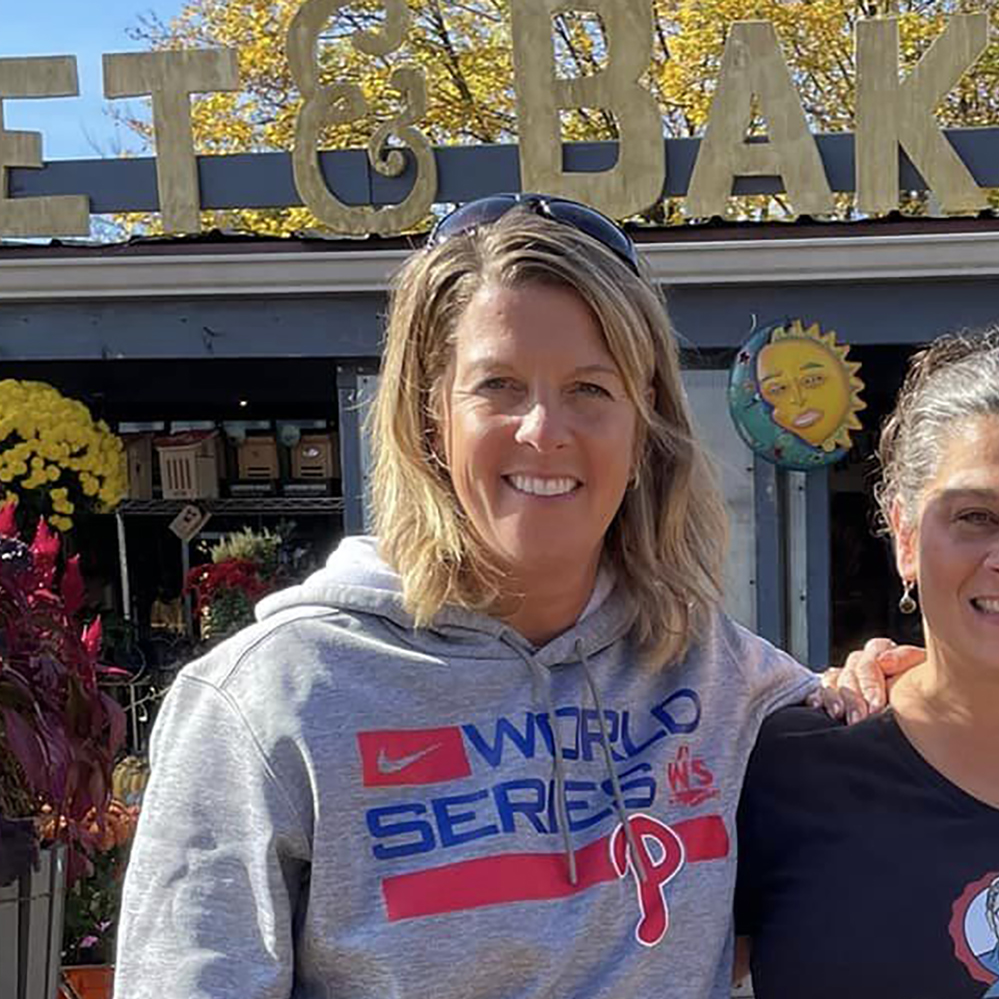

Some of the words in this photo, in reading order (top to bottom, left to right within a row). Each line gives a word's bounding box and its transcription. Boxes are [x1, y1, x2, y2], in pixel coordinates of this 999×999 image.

[0, 48, 238, 237] ET
[286, 0, 438, 236] &
[462, 688, 701, 768] WORLD
[365, 763, 658, 860] SERIES
[610, 813, 684, 946] P
